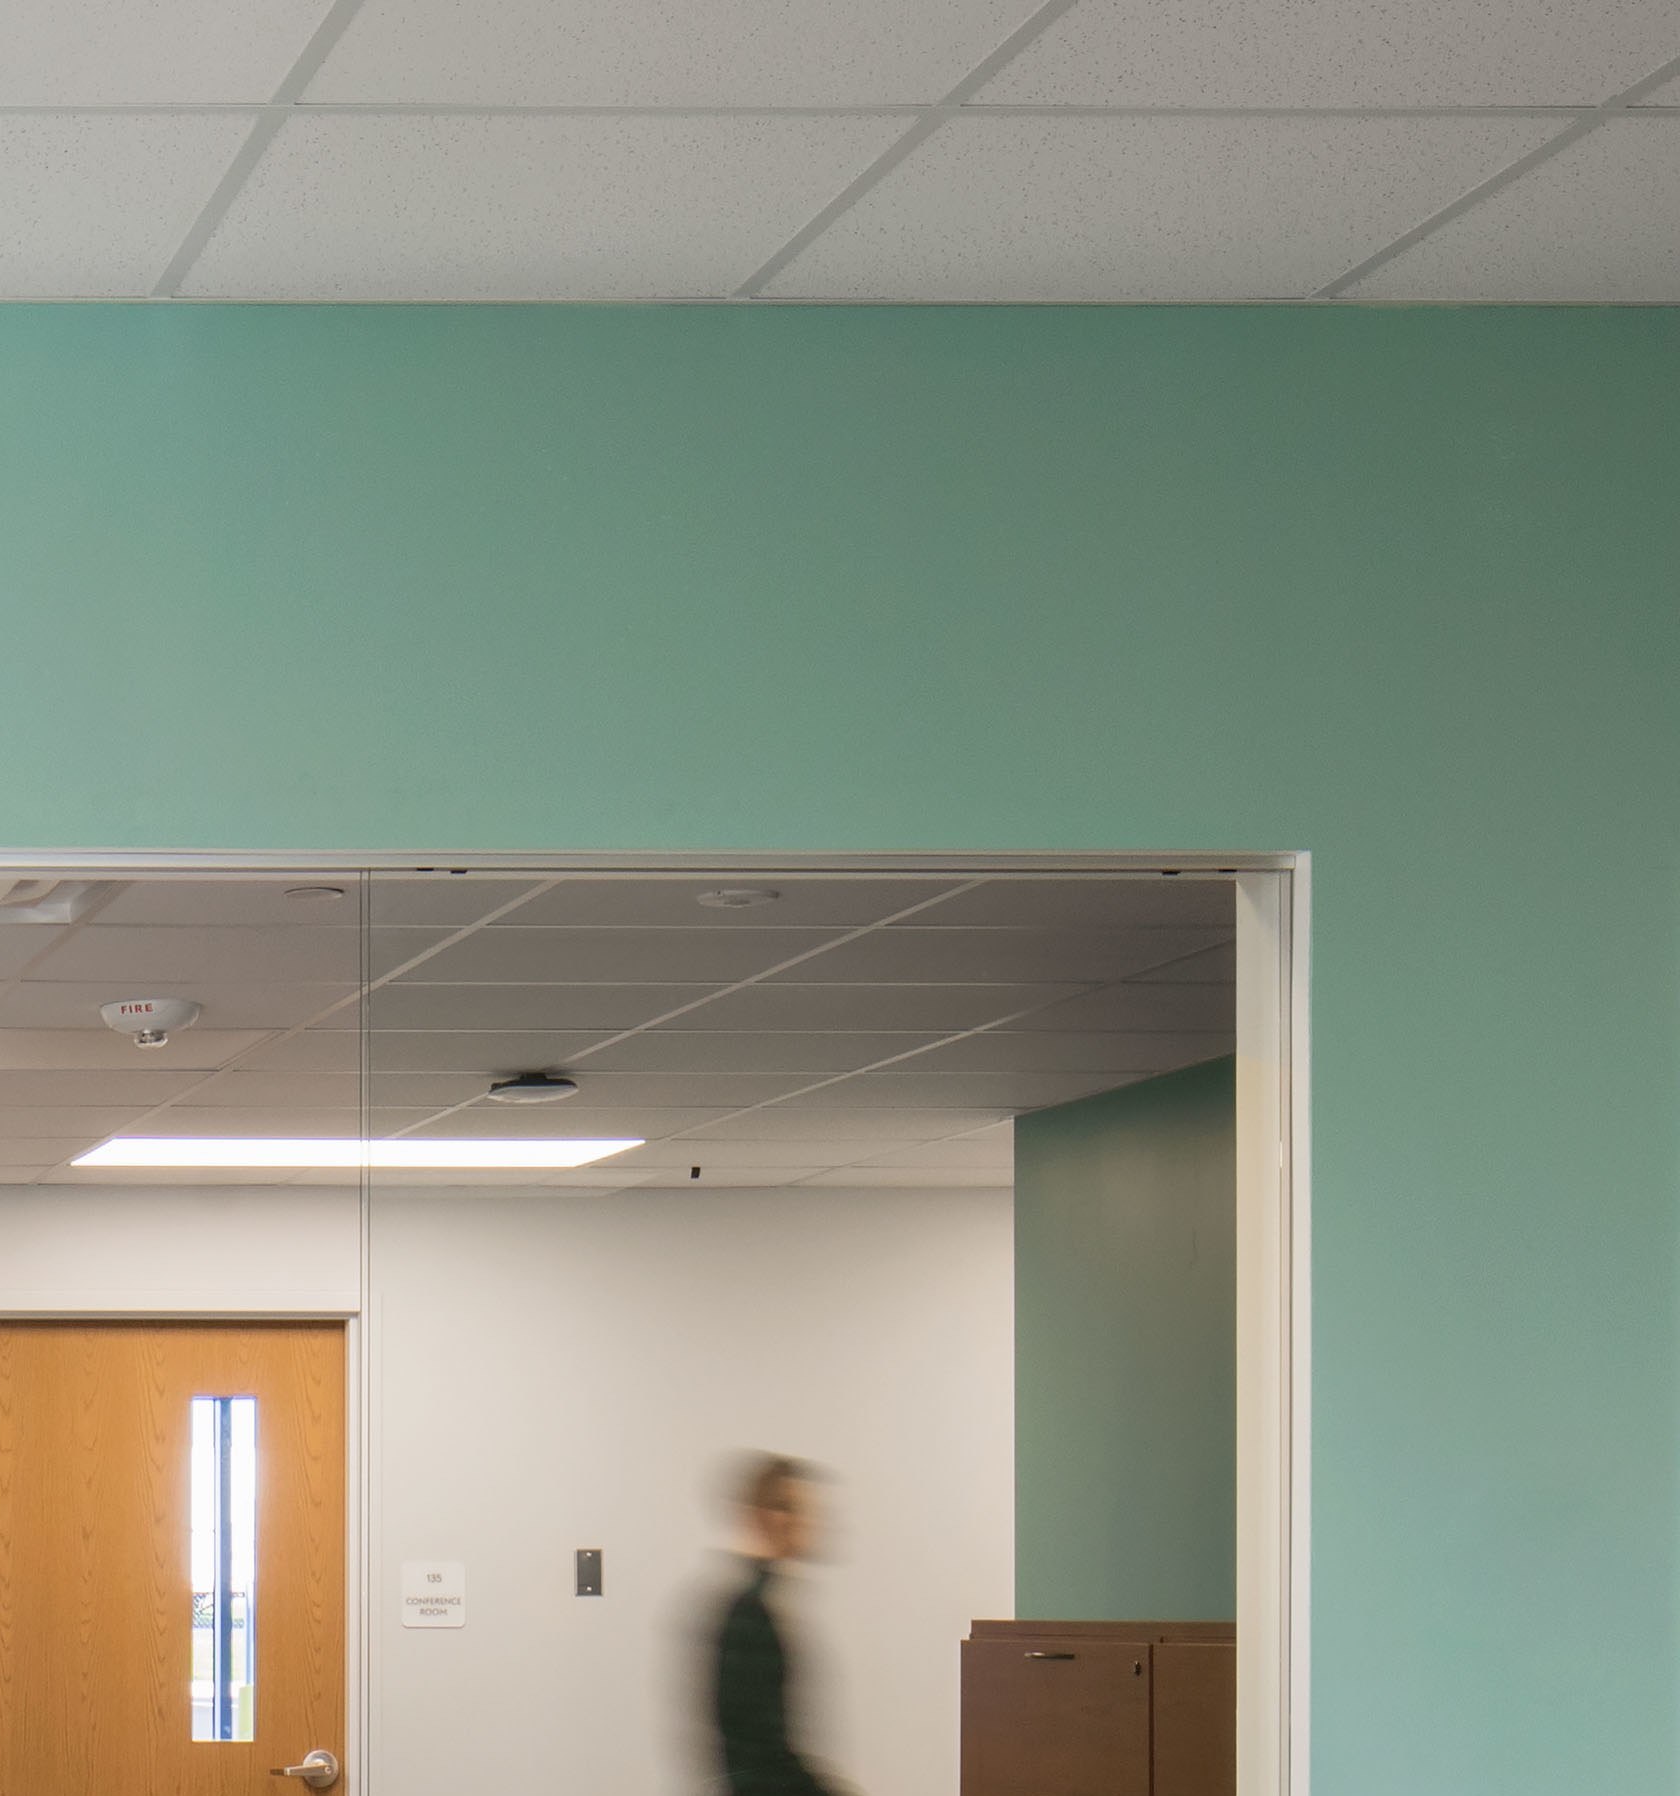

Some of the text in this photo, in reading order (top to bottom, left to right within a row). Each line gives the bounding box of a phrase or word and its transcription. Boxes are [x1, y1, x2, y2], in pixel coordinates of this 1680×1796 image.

[120, 1003, 153, 1014] FIRE
[426, 1573, 442, 1583] 135
[406, 1597, 461, 1606] CONFERENCE
[419, 1607, 448, 1616] ROOM
